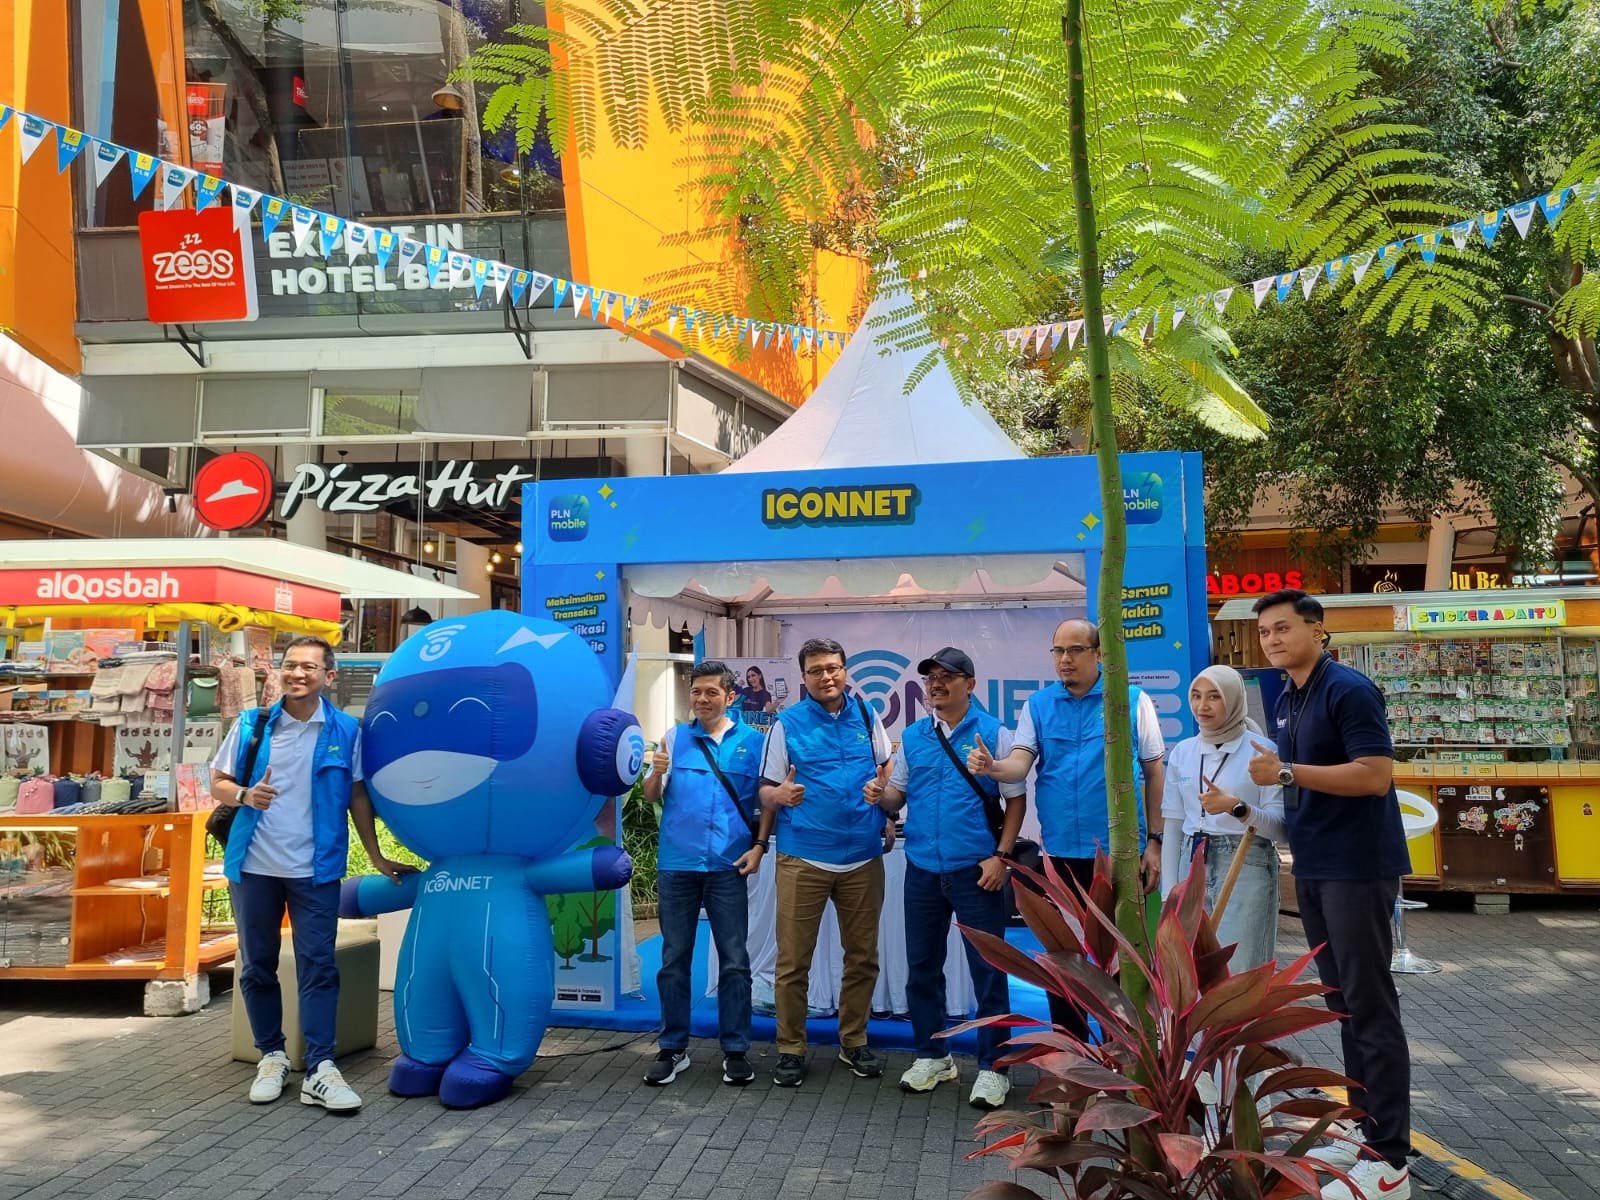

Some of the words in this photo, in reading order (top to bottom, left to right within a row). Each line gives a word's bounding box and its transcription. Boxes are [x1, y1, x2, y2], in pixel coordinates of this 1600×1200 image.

[60, 143, 78, 153] PLN
[134, 168, 150, 177] PLN
[200, 188, 215, 196] PLN
[425, 223, 464, 250] IN
[271, 265, 397, 295] HOTEL
[280, 462, 419, 518] Pizza
[426, 459, 534, 509] Hut
[1122, 488, 1140, 498] LN
[765, 488, 913, 521] ICONNET
[551, 509, 571, 519] PLN
[551, 518, 587, 530] mobile
[36, 570, 179, 604] alQosbah
[1205, 570, 1304, 594] ABOBS
[1121, 585, 1169, 599] Semua
[546, 593, 606, 607] Maksimalkan
[553, 606, 597, 620] Transaksi
[1417, 609, 1489, 623] STICKER
[1493, 606, 1557, 620] APAITU
[574, 621, 605, 635] likasi
[1122, 624, 1162, 638] udah
[423, 871, 494, 894] ICONNET
